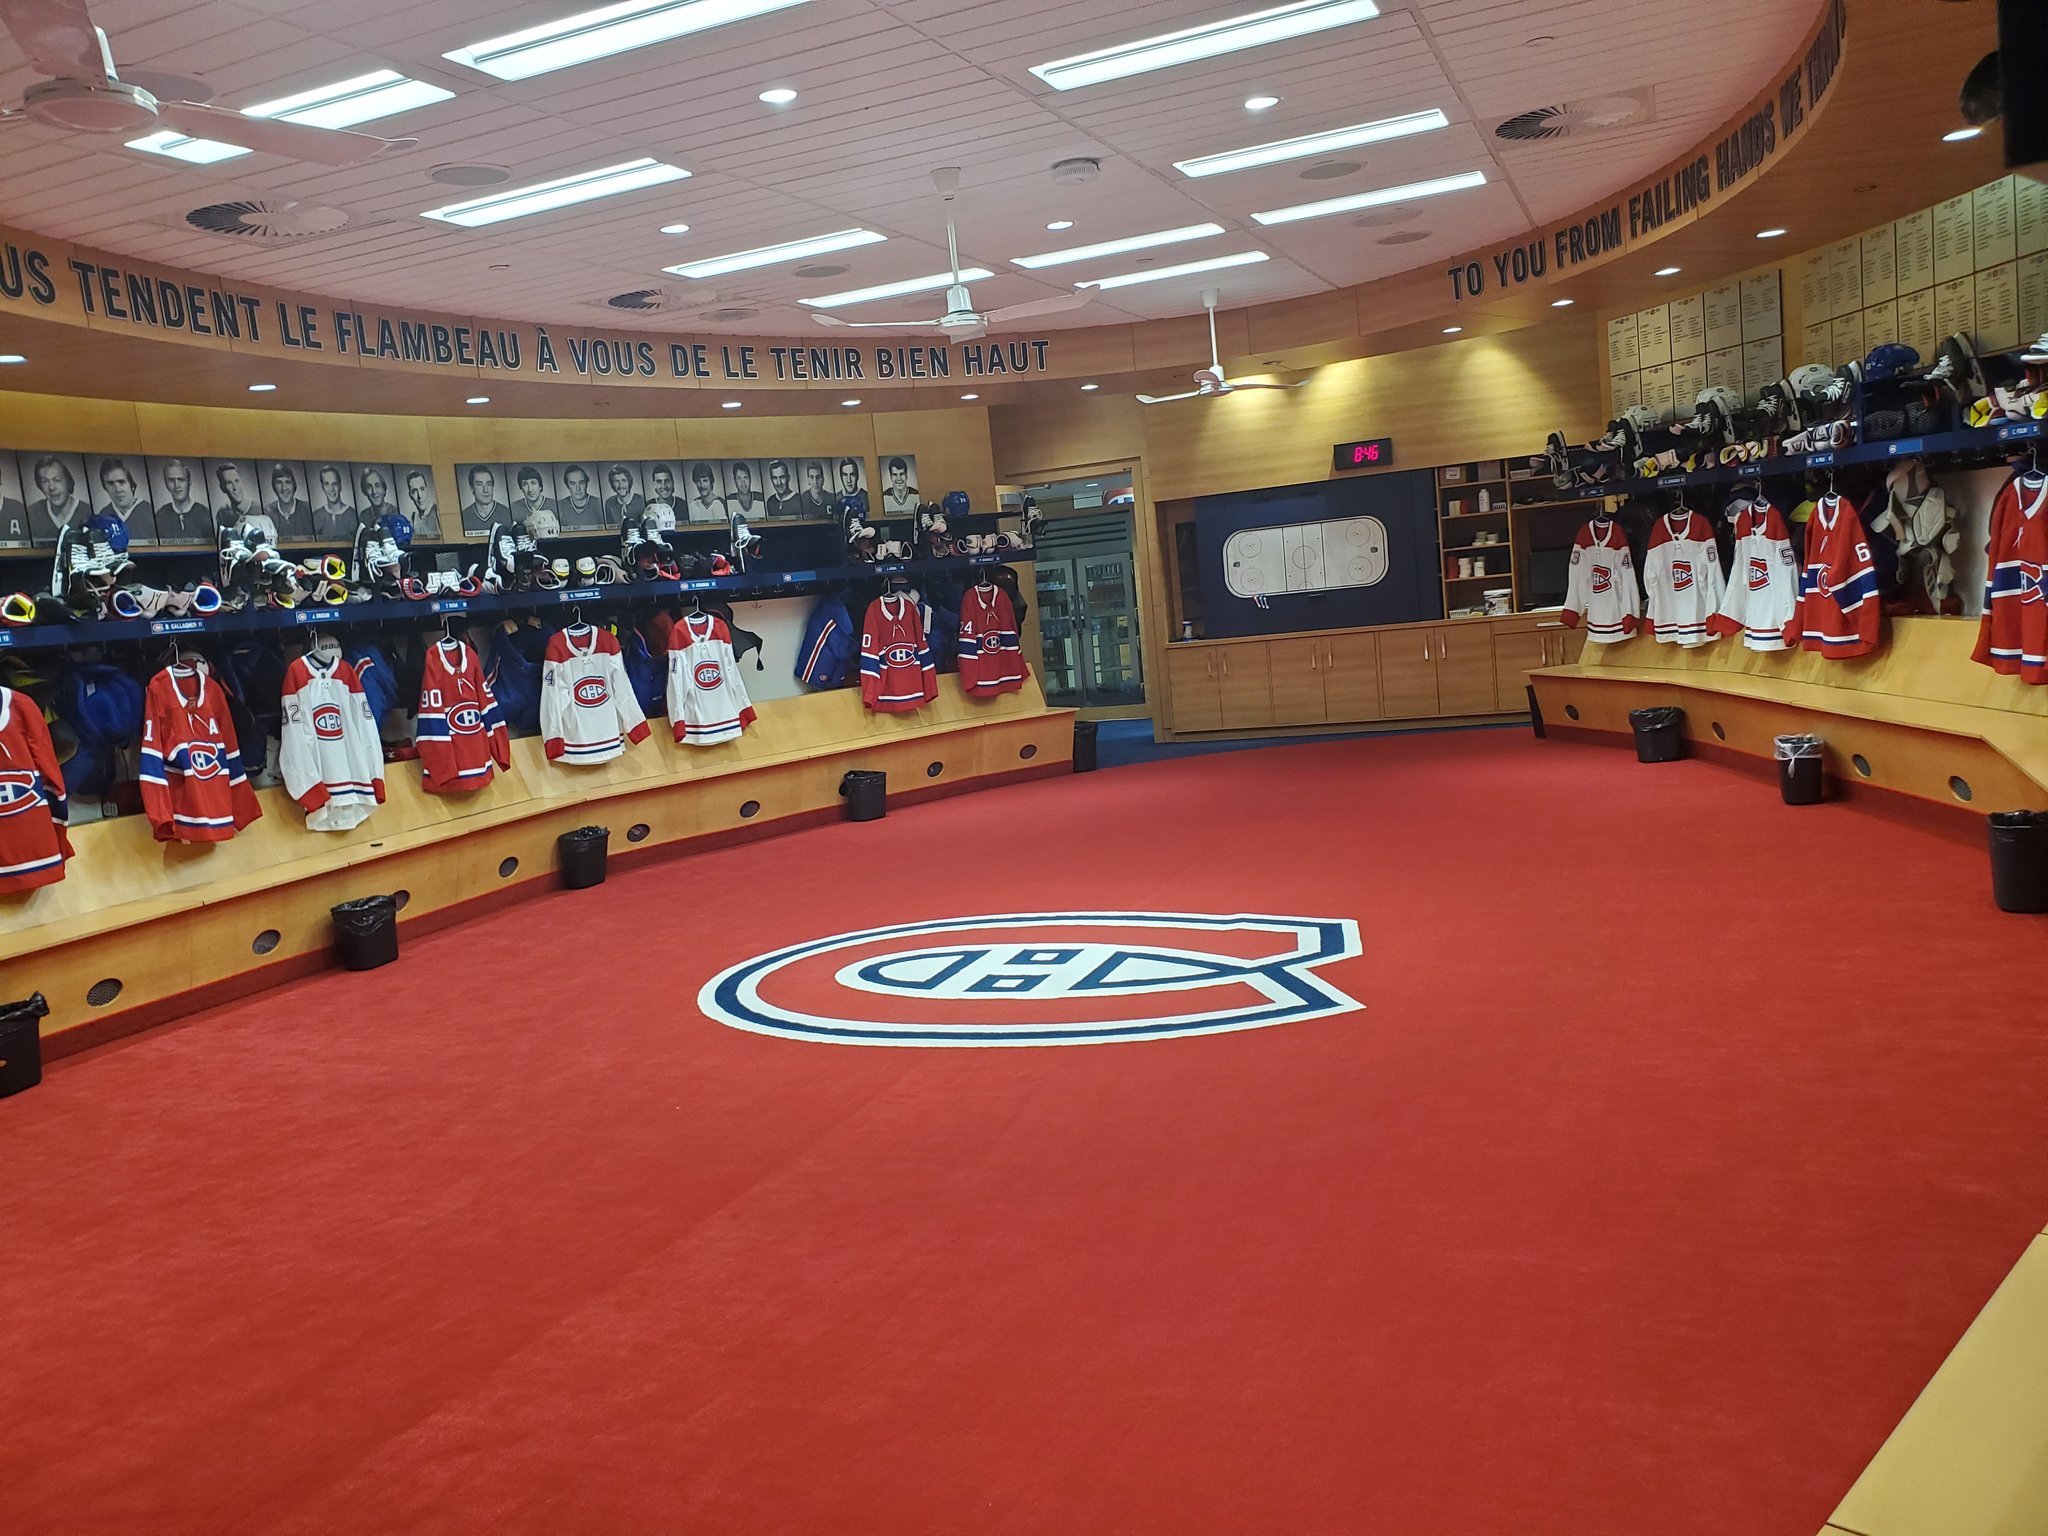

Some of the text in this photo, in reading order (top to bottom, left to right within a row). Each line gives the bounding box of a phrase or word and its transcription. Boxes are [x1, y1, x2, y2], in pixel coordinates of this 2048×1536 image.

[1447, 260, 1484, 301] TO
[1493, 237, 1547, 288] YOU
[1554, 204, 1623, 269] FROM
[1628, 153, 1711, 240] FAILING
[1715, 98, 1776, 192] HANDS
[1779, 64, 1803, 141] WE
[69, 257, 261, 342] TENDENT
[277, 301, 323, 350] LE
[333, 310, 521, 370] FLAMBEAU
[535, 326, 560, 373] À
[567, 337, 657, 377] VOUS
[670, 343, 711, 378] DE
[721, 345, 759, 380] LE
[769, 346, 866, 380] TENIR
[875, 346, 950, 379] BIEN
[963, 340, 1050, 377] HAUT
[1354, 445, 1379, 463] 8:46
[10, 519, 21, 535] A
[1855, 543, 1871, 562] 6
[422, 689, 443, 709] 90
[209, 718, 219, 735] A
